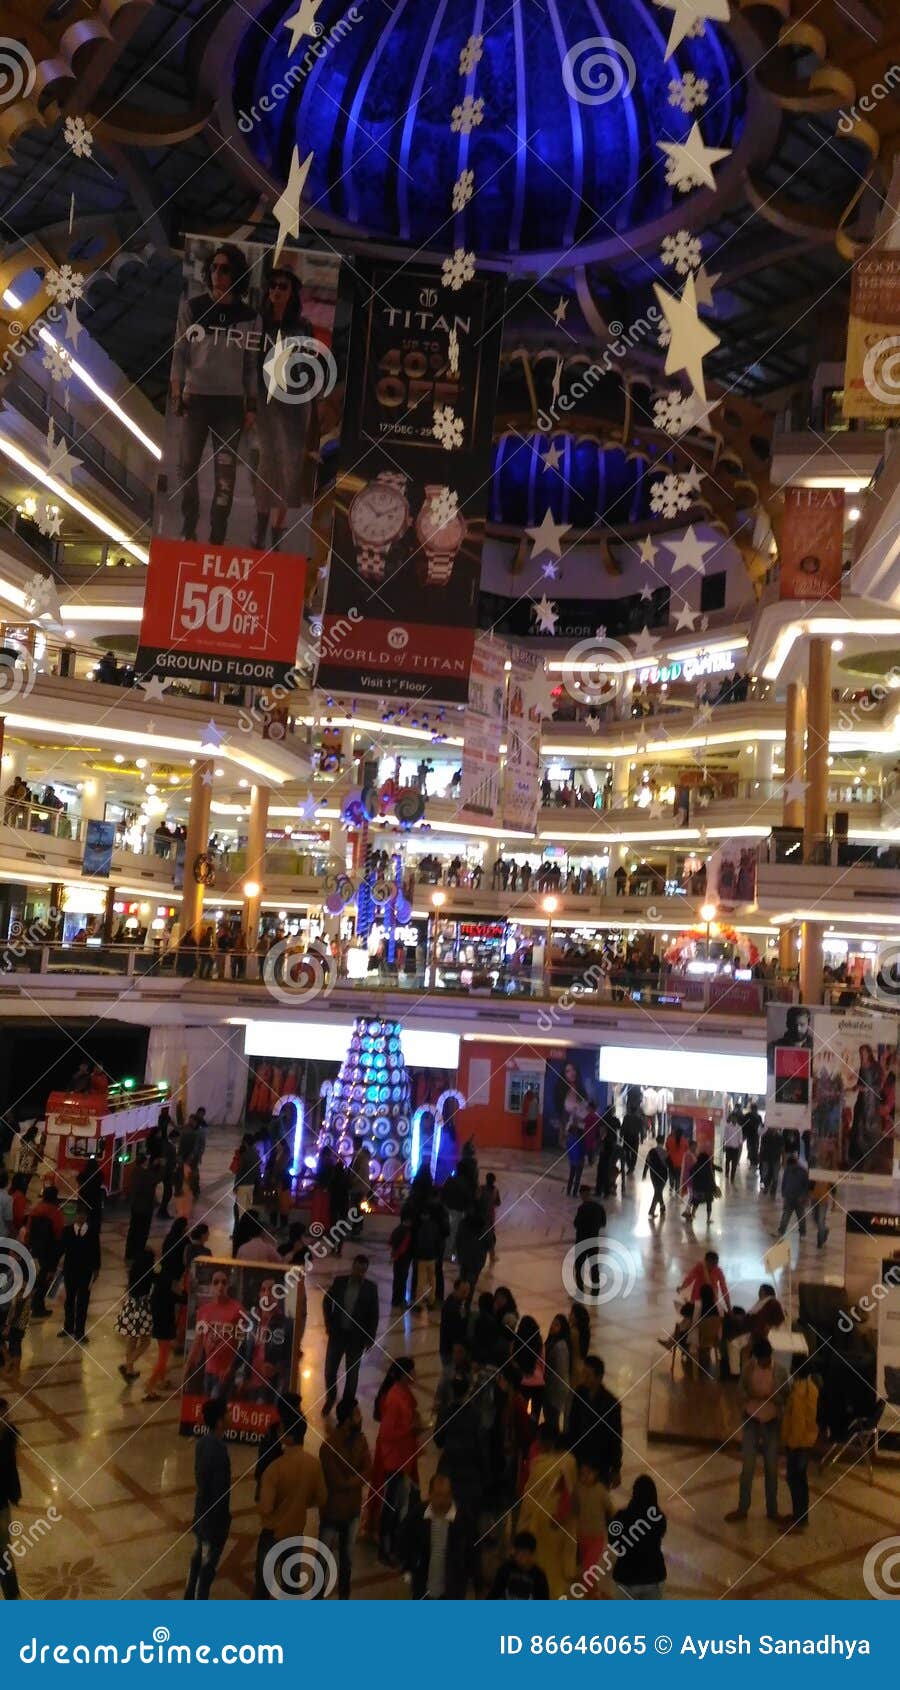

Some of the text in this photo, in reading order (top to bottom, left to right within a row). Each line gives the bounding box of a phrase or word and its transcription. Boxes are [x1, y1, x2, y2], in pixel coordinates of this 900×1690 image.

[383, 308, 471, 335] TITAN
[208, 326, 321, 358] TRENDS
[376, 376, 463, 411] OFF
[202, 554, 254, 581] FLAT
[233, 613, 260, 636] OFF
[156, 653, 275, 679] GROUND FLOOR
[329, 648, 465, 671] WORLD of TITAN
[361, 676, 383, 688] Visit
[400, 680, 427, 692] Floor
[212, 1321, 286, 1345] TRENDS
